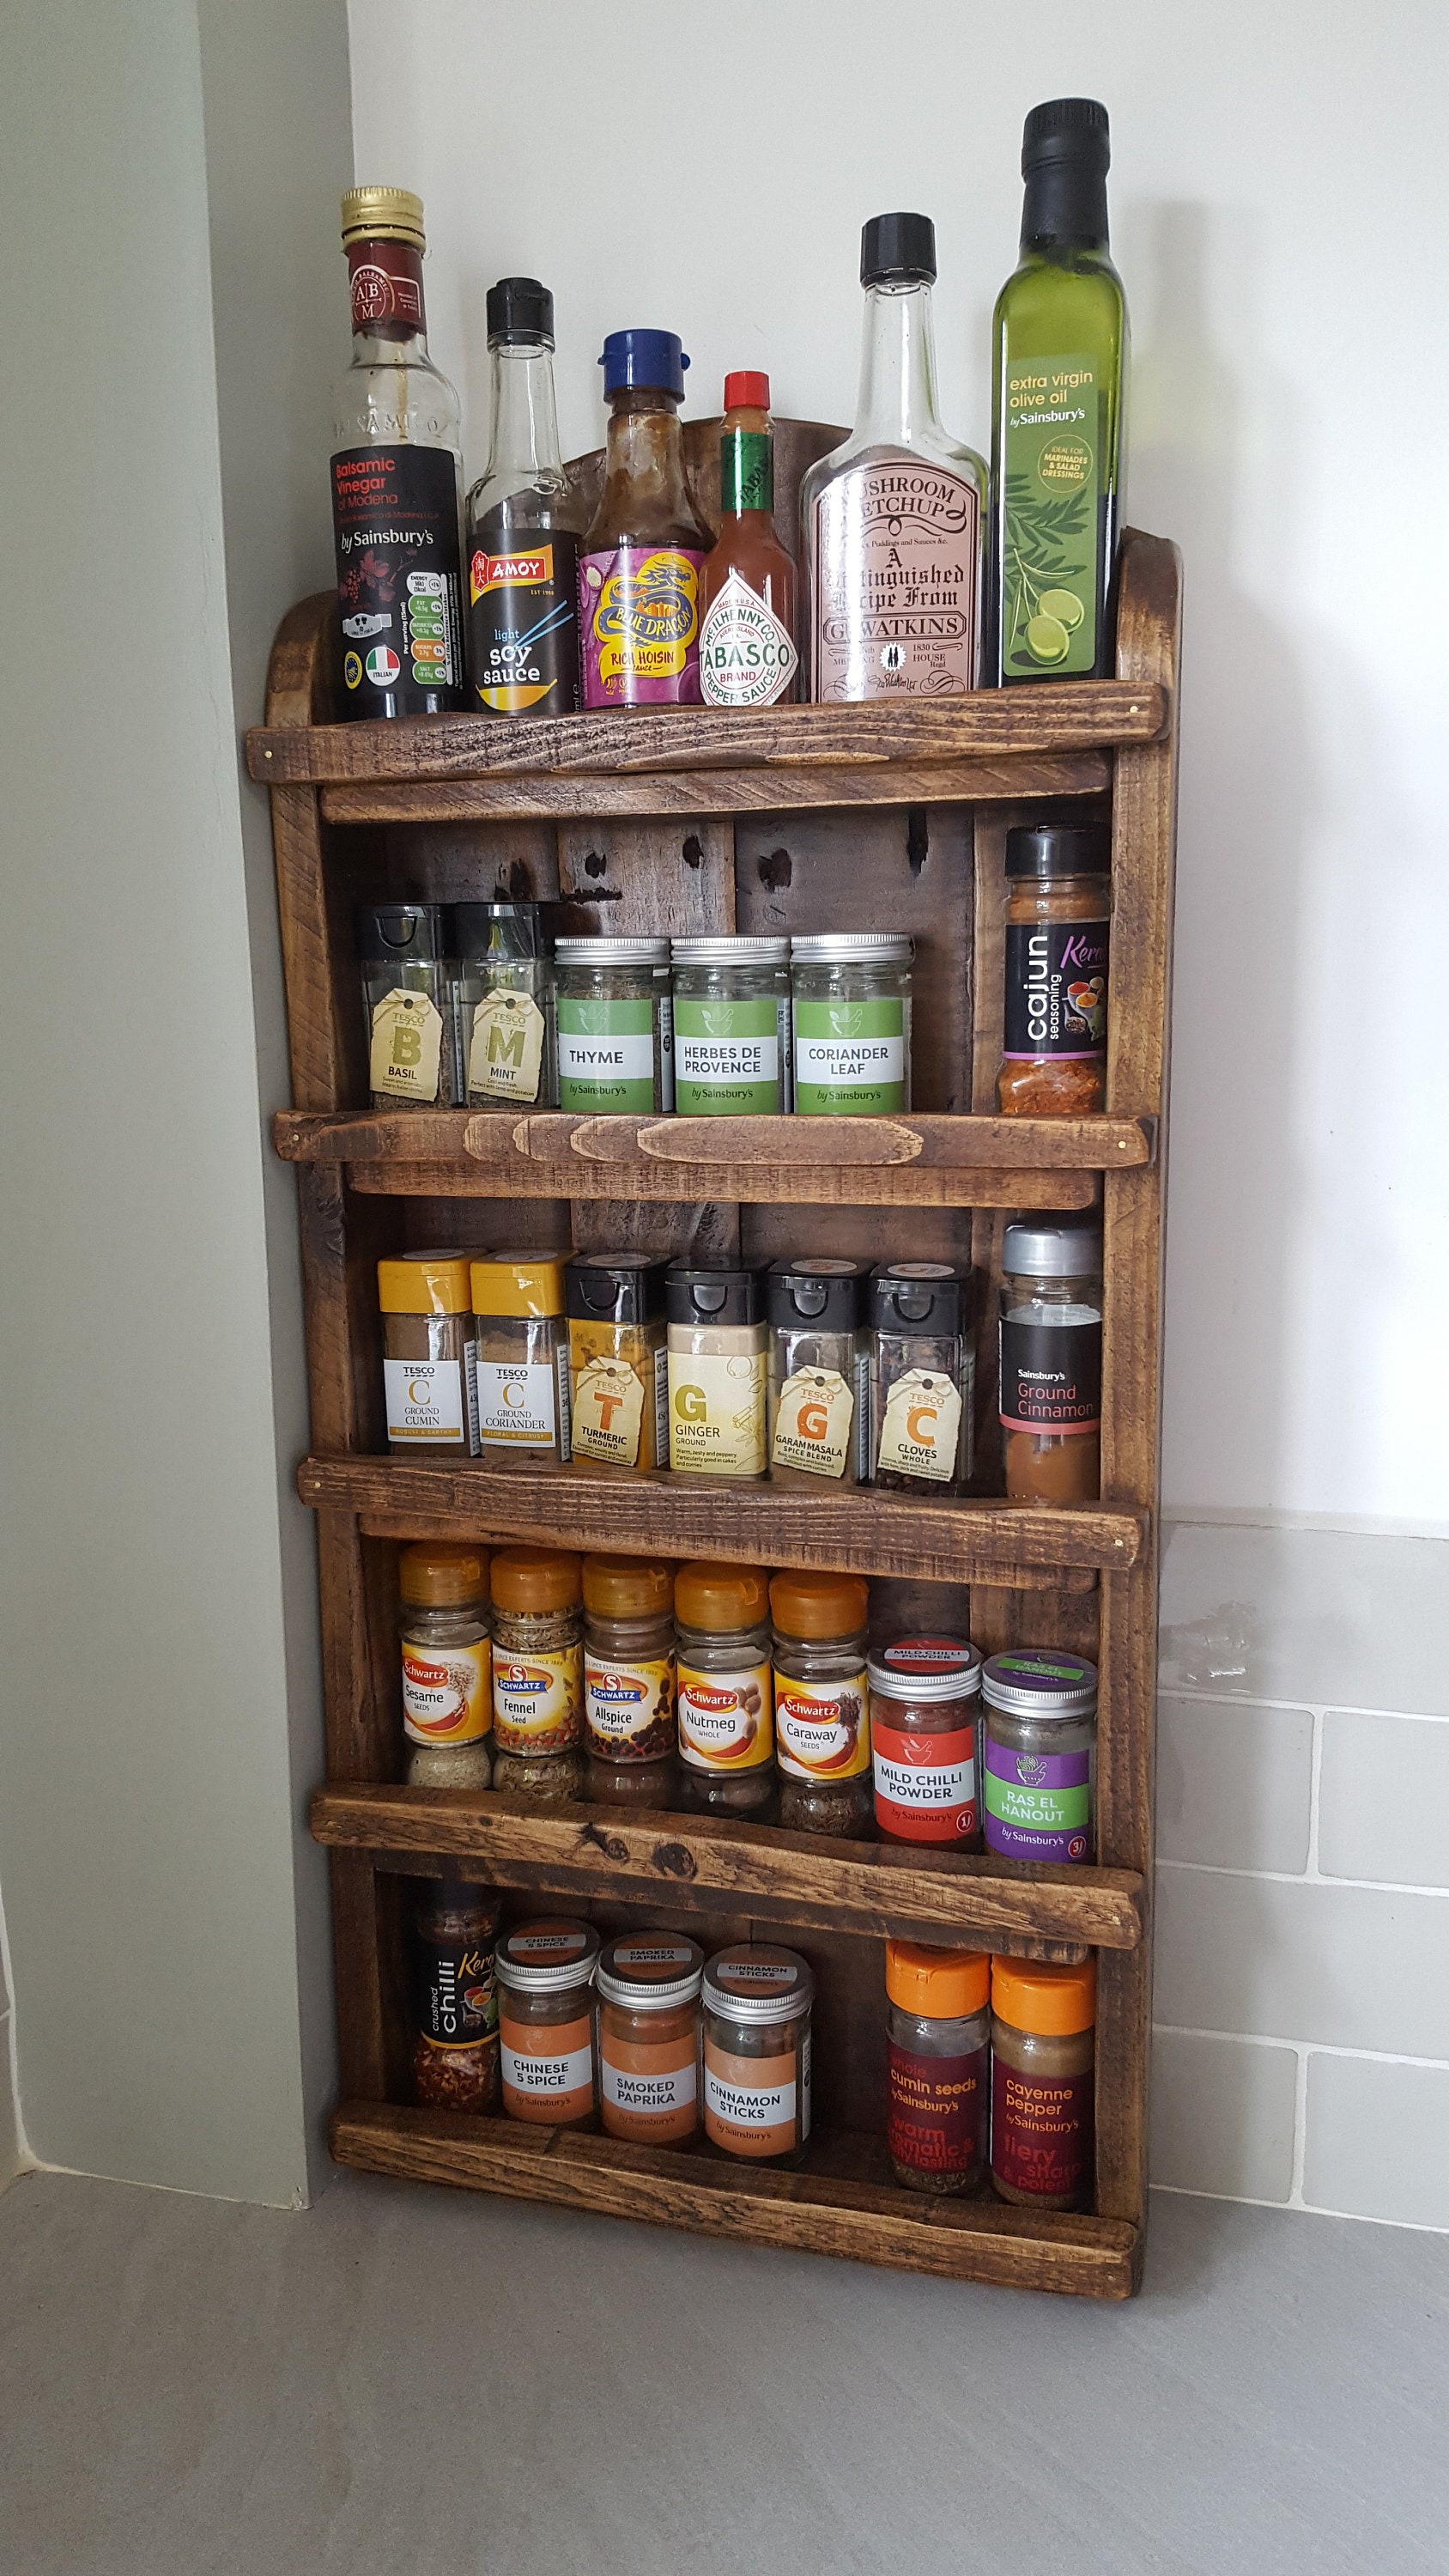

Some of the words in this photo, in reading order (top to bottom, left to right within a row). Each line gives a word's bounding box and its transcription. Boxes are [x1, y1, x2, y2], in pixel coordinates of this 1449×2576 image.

[1009, 376, 1047, 391] extra
[1052, 371, 1093, 388] virgin
[1009, 393, 1046, 408] olive
[1050, 390, 1068, 404] oil
[1009, 417, 1020, 428] by
[1020, 407, 1085, 425] Sainsbury's
[336, 457, 396, 478] Balsamic
[1044, 453, 1088, 465] MARINADES
[1056, 462, 1081, 471] SALAD
[1042, 469, 1085, 479] DRESSINGS
[336, 477, 386, 495] Vinegar
[861, 477, 955, 504] USHROOM
[348, 494, 398, 508] Modena
[861, 496, 944, 518] ETCHUP
[342, 533, 353, 554] by
[354, 529, 434, 547] Sainsbury's
[886, 548, 902, 568] A
[492, 562, 540, 579] AMOY
[903, 587, 958, 608] From
[616, 607, 645, 632] BLUE
[645, 609, 692, 638] DRAGON
[863, 617, 958, 638] WATKINS
[494, 629, 520, 641] light
[489, 646, 532, 668] soy
[611, 652, 635, 666] RICH
[639, 651, 675, 665] HOISIN
[700, 643, 790, 672] TABASCO
[483, 666, 541, 684] sauce
[720, 671, 756, 683] BRAND
[706, 671, 738, 704] PEPPER
[742, 668, 777, 702] SAUCE
[1023, 936, 1050, 1041] cajun
[1049, 974, 1063, 1040] seasoning
[392, 1012, 426, 1024] TESCO
[494, 1012, 526, 1024] TESCO
[393, 1025, 421, 1066] B
[488, 1025, 526, 1067] M
[684, 1046, 737, 1059] HERBES
[742, 1047, 761, 1059] DE
[809, 1048, 889, 1060] CORIANDER
[570, 1050, 624, 1064] THYME
[388, 1066, 417, 1080] BASIL
[490, 1066, 517, 1080] MINT
[685, 1060, 761, 1073] PROVENCE
[831, 1063, 865, 1075] LEAF
[570, 1084, 579, 1096] by
[579, 1085, 627, 1097] Sainsbury's
[692, 1087, 702, 1101] by
[702, 1089, 754, 1100] Sainsbury's
[817, 1091, 828, 1103] by
[829, 1091, 881, 1102] Sainsbury's
[496, 1369, 528, 1377] TESCO
[1018, 1369, 1065, 1382] Sainsbury's
[409, 1380, 431, 1405] C
[503, 1382, 524, 1408] C
[596, 1380, 627, 1393] TESCO
[801, 1388, 835, 1400] TESCO
[1018, 1382, 1076, 1400] Ground
[675, 1384, 706, 1423] G
[910, 1393, 945, 1405] TESCO
[404, 1406, 440, 1415] GROUND
[497, 1410, 531, 1419] GROUND
[594, 1392, 623, 1431] T
[1018, 1401, 1094, 1418] Cinnamon
[405, 1416, 440, 1425] CUMIN
[486, 1418, 546, 1430] CORIANDER
[797, 1403, 828, 1440] G
[906, 1406, 937, 1447] C
[582, 1426, 627, 1445] TURMERIC
[676, 1425, 720, 1437] GINGER
[588, 1437, 618, 1450] GROUND
[676, 1437, 706, 1446] GROUND
[776, 1435, 806, 1449] GARAM
[807, 1443, 843, 1457] MASALA
[784, 1446, 804, 1455] SPICE
[807, 1451, 832, 1461] BLEND
[898, 1443, 937, 1459] CLOVES
[902, 1455, 931, 1465] WHOLE
[404, 1662, 446, 1680] Schwartz
[500, 1680, 540, 1690] SCHWARTZ
[592, 1688, 635, 1699] SCHWARTZ
[406, 1685, 444, 1704] Sesame
[687, 1688, 734, 1706] Schwartz
[505, 1698, 536, 1714] Fennel
[785, 1699, 835, 1716] Schwartz
[512, 1716, 526, 1724] Seed
[596, 1706, 632, 1724] Allspice
[687, 1710, 736, 1732] Nutmeg
[601, 1723, 624, 1734] Ground
[698, 1729, 720, 1739] WHOLE
[786, 1722, 837, 1742] Caraway
[800, 1741, 820, 1750] SEEDS
[881, 1765, 912, 1784] MILD
[916, 1772, 962, 1787] CHILLI
[889, 1783, 953, 1799] POWDER
[1007, 1791, 1037, 1808] RAS
[1040, 1796, 1058, 1808] EL
[891, 1808, 901, 1820] by
[901, 1810, 952, 1822] Sainsbury's
[1001, 1802, 1064, 1822] HANOUT
[1002, 1826, 1012, 1840] by
[1013, 1831, 1064, 1846] Sainsbury's
[728, 1965, 787, 1973] CINNAMON
[439, 1961, 457, 2033] chilli
[429, 1986, 440, 2032] crushed
[513, 2060, 569, 2075] CHINESE
[517, 2073, 524, 2082] 5
[527, 2075, 566, 2086] SPICE
[616, 2078, 675, 2092] SMOKED
[891, 2068, 931, 2094] cumin
[935, 2077, 977, 2096] seeds
[617, 2090, 676, 2105] PAPRIKA
[710, 2081, 781, 2107] CINNAMON
[1006, 2080, 1073, 2100] cayenne
[524, 2096, 571, 2107] Sainsbury's
[719, 2100, 766, 2119] STICKS
[897, 2089, 959, 2114] Sainsbury's
[1006, 2093, 1062, 2117] pepper
[628, 2116, 676, 2126] Sainsbury's
[1006, 2112, 1015, 2124] by
[1015, 2114, 1079, 2133] Sainsbury's
[716, 2121, 724, 2133] by
[724, 2127, 772, 2140] Sainsbury's
